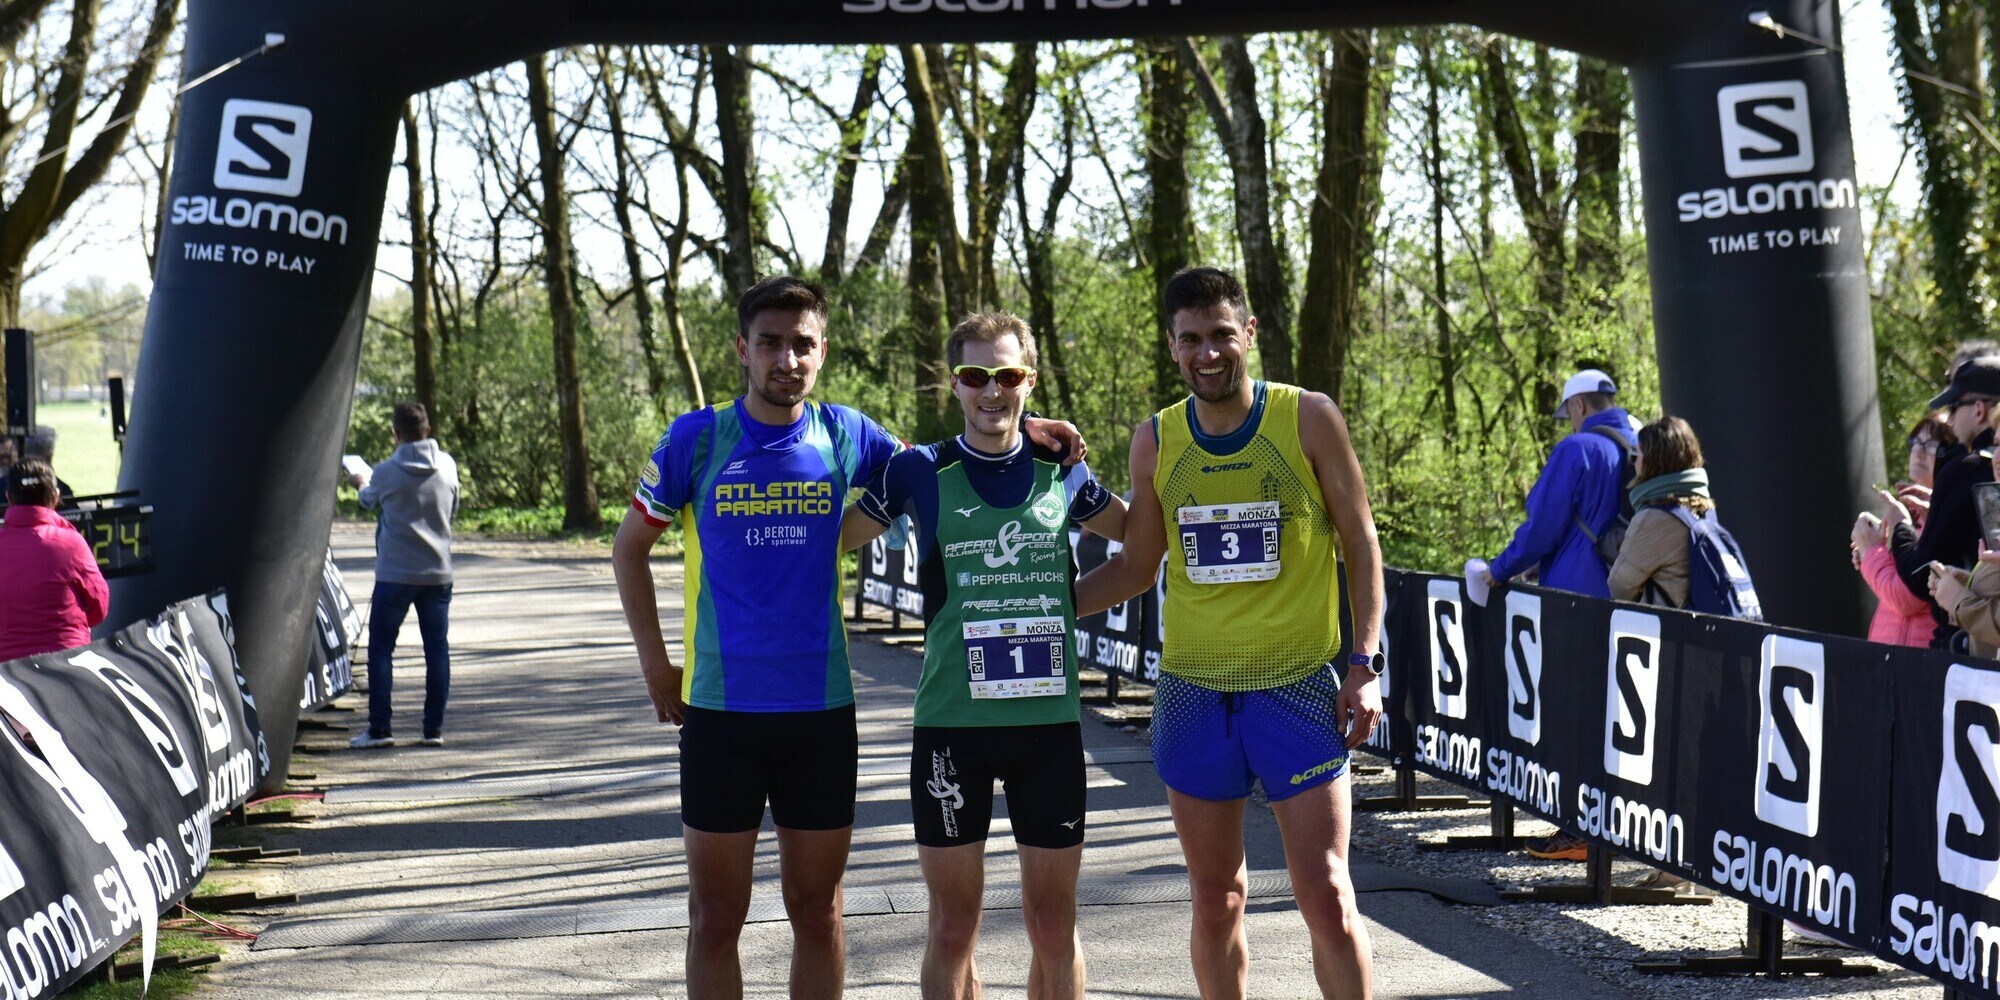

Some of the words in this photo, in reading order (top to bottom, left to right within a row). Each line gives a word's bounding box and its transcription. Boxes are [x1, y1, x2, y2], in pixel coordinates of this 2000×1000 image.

[1677, 178, 1855, 222] salomon
[171, 195, 347, 245] salomon
[1708, 232, 1760, 255] TIME
[1764, 229, 1794, 249] TO
[1799, 226, 1841, 246] PLAY
[184, 242, 225, 262] TIME
[231, 246, 259, 265] TO
[265, 250, 316, 275] PLAY
[1211, 461, 1253, 473] CRAZY
[715, 481, 832, 499] ATLETICA
[715, 498, 832, 517] PARATICO
[1238, 509, 1277, 520] MONZA
[764, 525, 807, 538] BERTONI
[1241, 521, 1278, 529] MARATONA
[771, 538, 807, 548] sportwear
[944, 548, 995, 558] VILLASANTA
[945, 539, 997, 553] AFFARI
[984, 520, 1021, 568] &
[1010, 532, 1060, 543] SPORT
[1029, 551, 1056, 564] Racing
[1221, 531, 1240, 560] 3
[971, 571, 1065, 586] PEPPERL+FUCHS
[1026, 624, 1063, 635] MONZA
[1009, 645, 1024, 674] 1
[932, 750, 942, 790] SPORT
[1302, 755, 1345, 782] CRAZY
[1487, 746, 1561, 819] salomon
[941, 799, 953, 838] AFFARI
[1577, 783, 1684, 868] salomon
[1711, 830, 1856, 935] salomon
[0, 893, 96, 1000] lomon
[1889, 893, 2000, 996] salom
